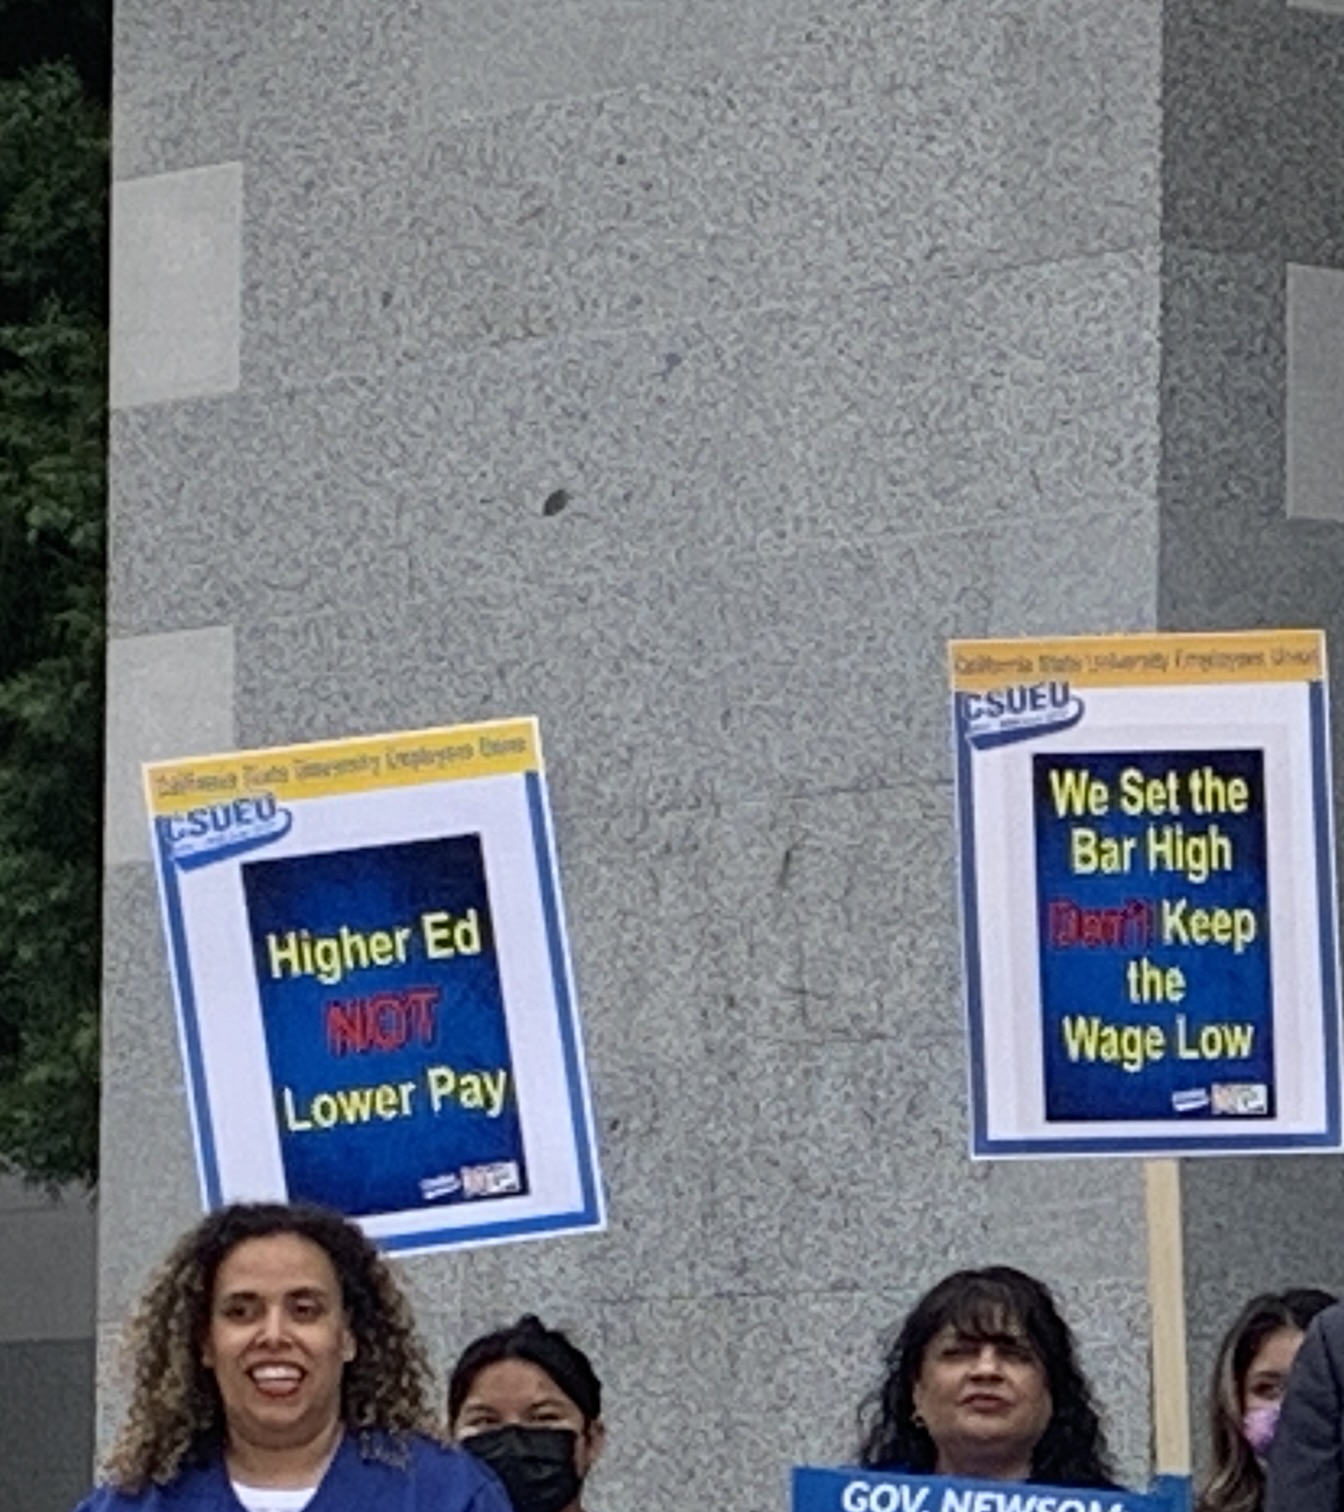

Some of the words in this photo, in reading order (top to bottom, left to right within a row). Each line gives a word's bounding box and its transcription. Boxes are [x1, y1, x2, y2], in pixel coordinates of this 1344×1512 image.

[1050, 769, 1109, 818] We
[1119, 768, 1180, 816] Set
[1190, 766, 1249, 813] the
[1071, 827, 1136, 874] Bar
[1148, 823, 1232, 882] High
[267, 926, 410, 984] Higher
[422, 908, 481, 958] Ed
[1162, 899, 1255, 954] Keep
[1128, 958, 1186, 1003] the
[326, 985, 443, 1057] NOT
[1063, 1016, 1166, 1071] Wage
[1177, 1015, 1253, 1060] Low
[283, 1081, 414, 1132] Lower
[427, 1066, 506, 1117] Pay
